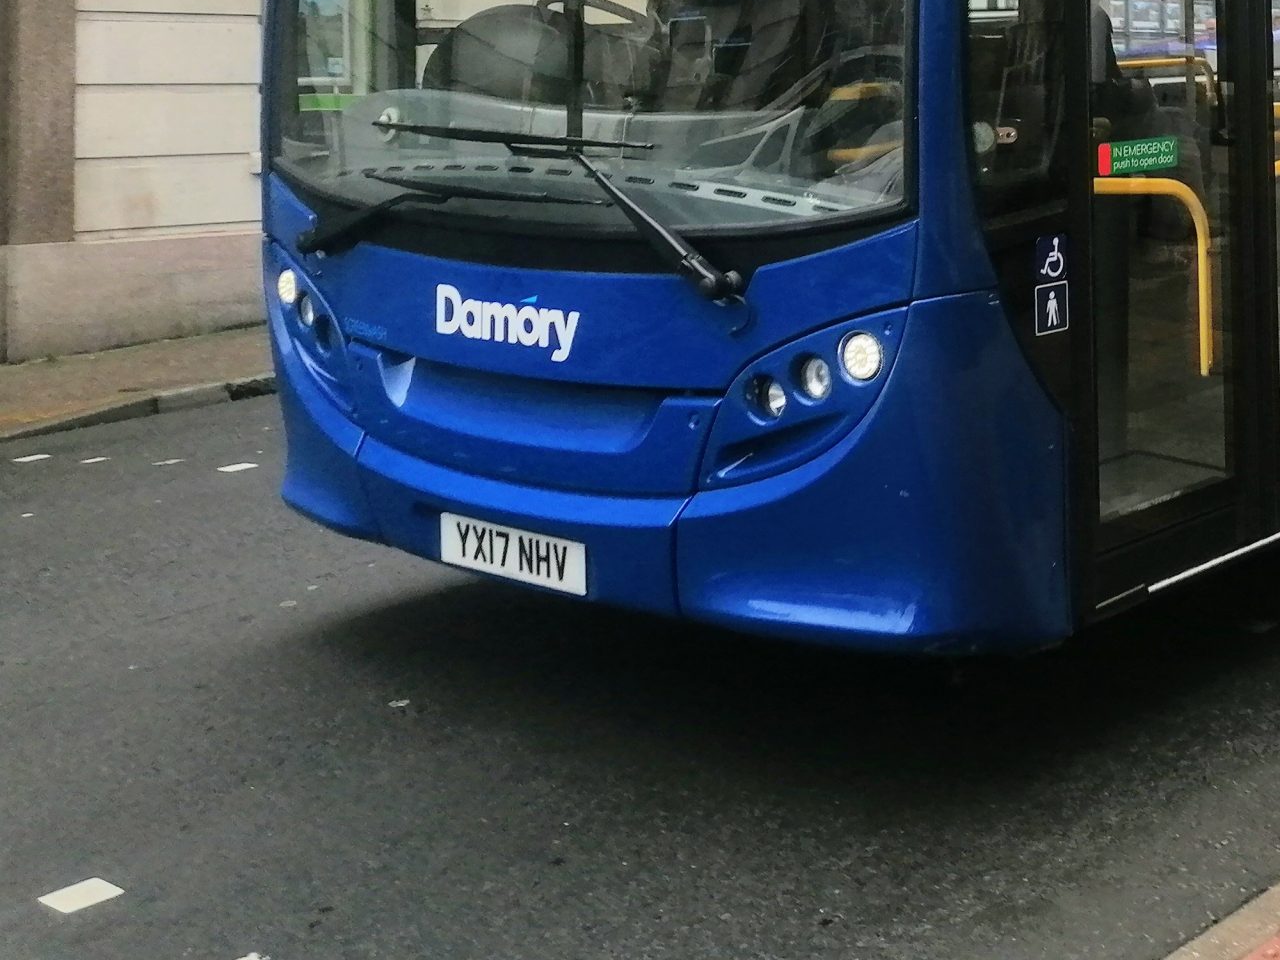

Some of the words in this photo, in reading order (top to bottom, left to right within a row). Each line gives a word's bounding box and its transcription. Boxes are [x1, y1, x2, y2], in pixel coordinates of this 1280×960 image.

[1113, 146, 1123, 158] IN
[1123, 140, 1175, 157] EMERGENCY
[1113, 158, 1131, 173] push
[1131, 158, 1139, 168] to
[1139, 156, 1158, 169] open
[1158, 153, 1174, 165] door
[456, 521, 510, 568] YX17
[518, 535, 568, 582] NHV
